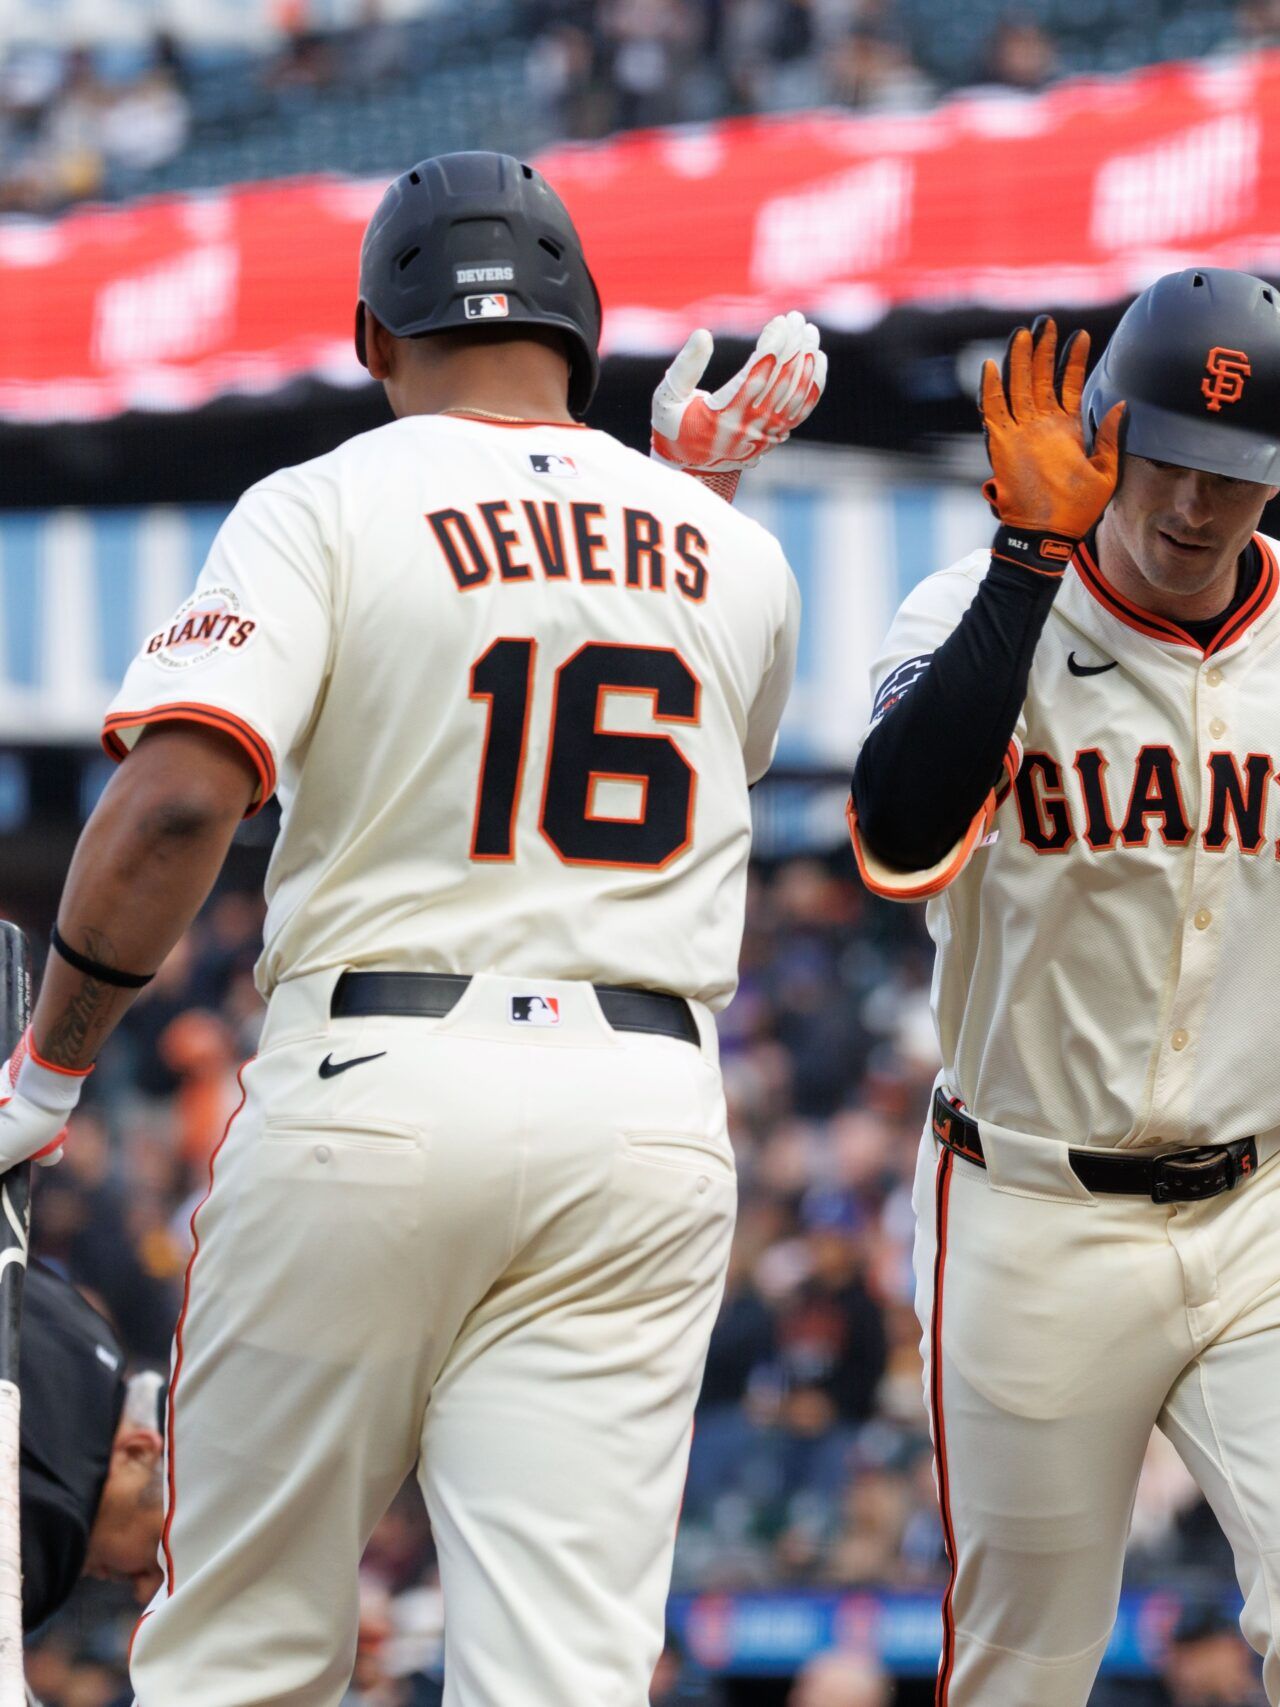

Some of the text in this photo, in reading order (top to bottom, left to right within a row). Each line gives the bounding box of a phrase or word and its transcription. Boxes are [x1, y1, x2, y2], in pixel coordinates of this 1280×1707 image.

[456, 266, 514, 284] DEVERS
[425, 499, 709, 604] DEVERS
[1007, 537, 1022, 549] YAZ
[146, 613, 256, 654] GIANTS
[468, 636, 702, 872] 16
